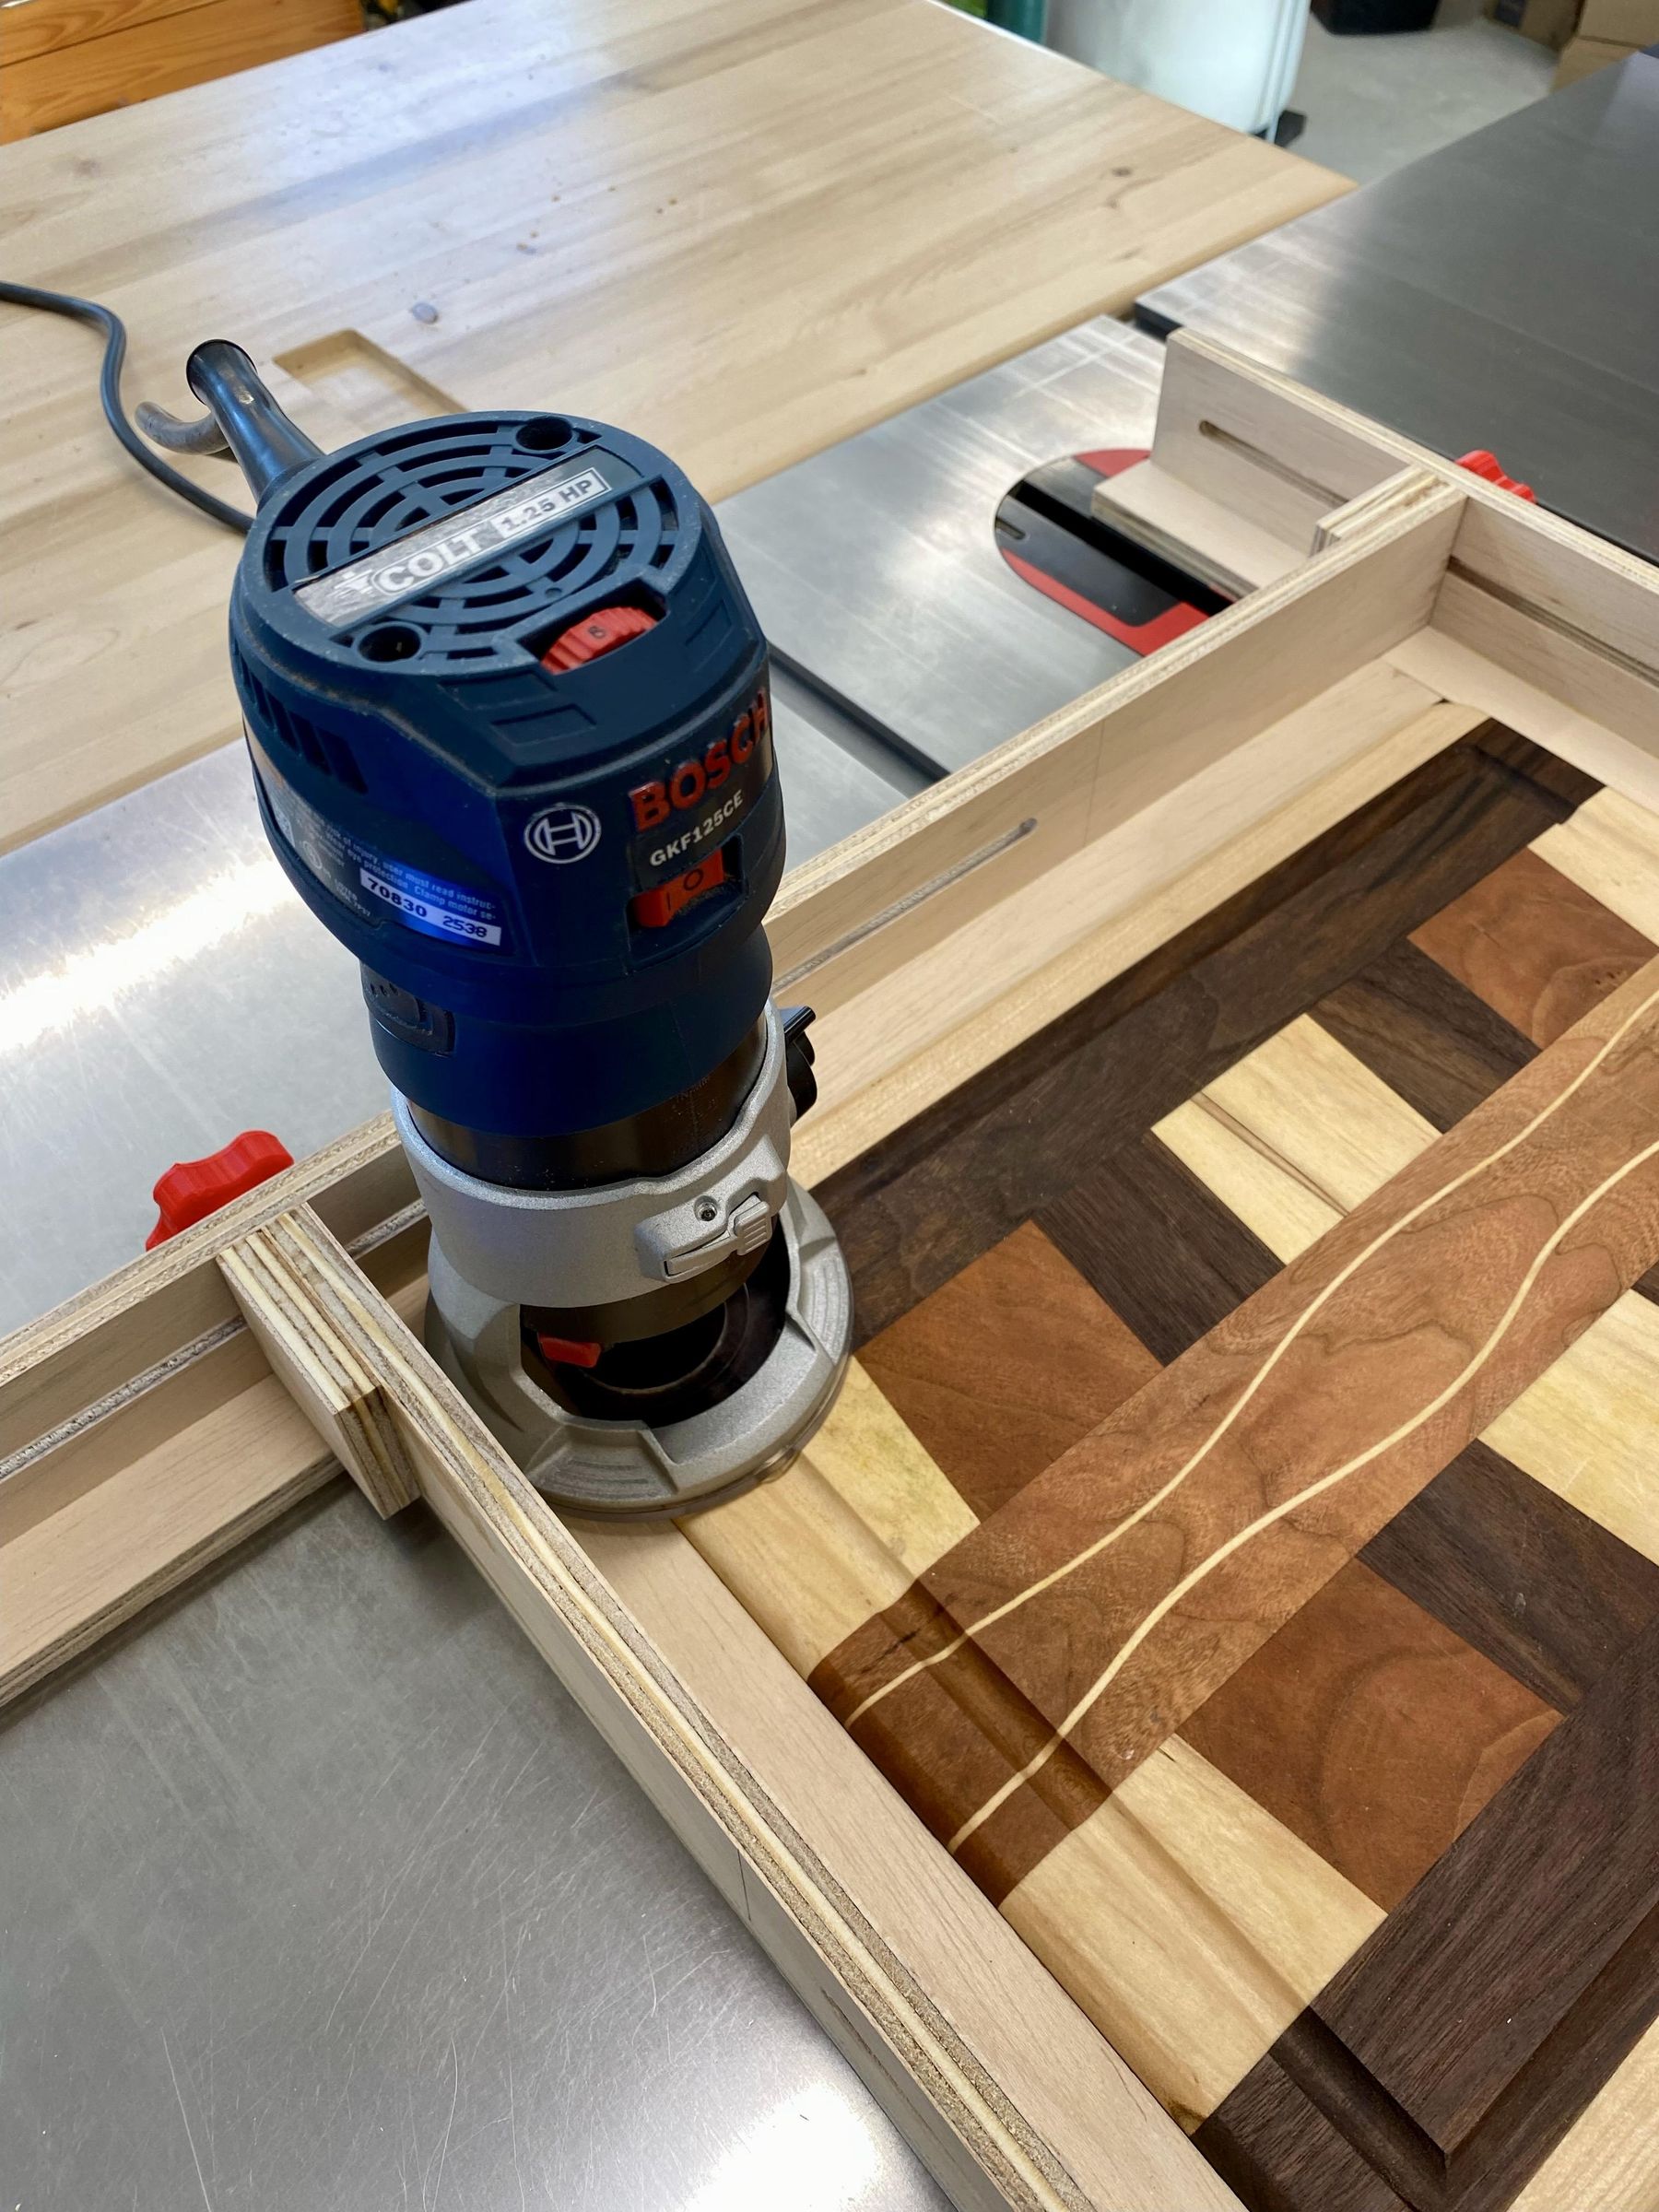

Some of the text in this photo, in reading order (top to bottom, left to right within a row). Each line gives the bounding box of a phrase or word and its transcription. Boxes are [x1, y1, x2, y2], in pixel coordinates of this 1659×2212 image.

[381, 479, 594, 593] COLT 1.25 HP
[629, 687, 770, 833] BOSCH
[649, 789, 745, 867] GKF125CE
[367, 877, 428, 918] 70830
[442, 915, 488, 938] 2538
[414, 886, 446, 906] Clamp
[431, 884, 455, 899] read
